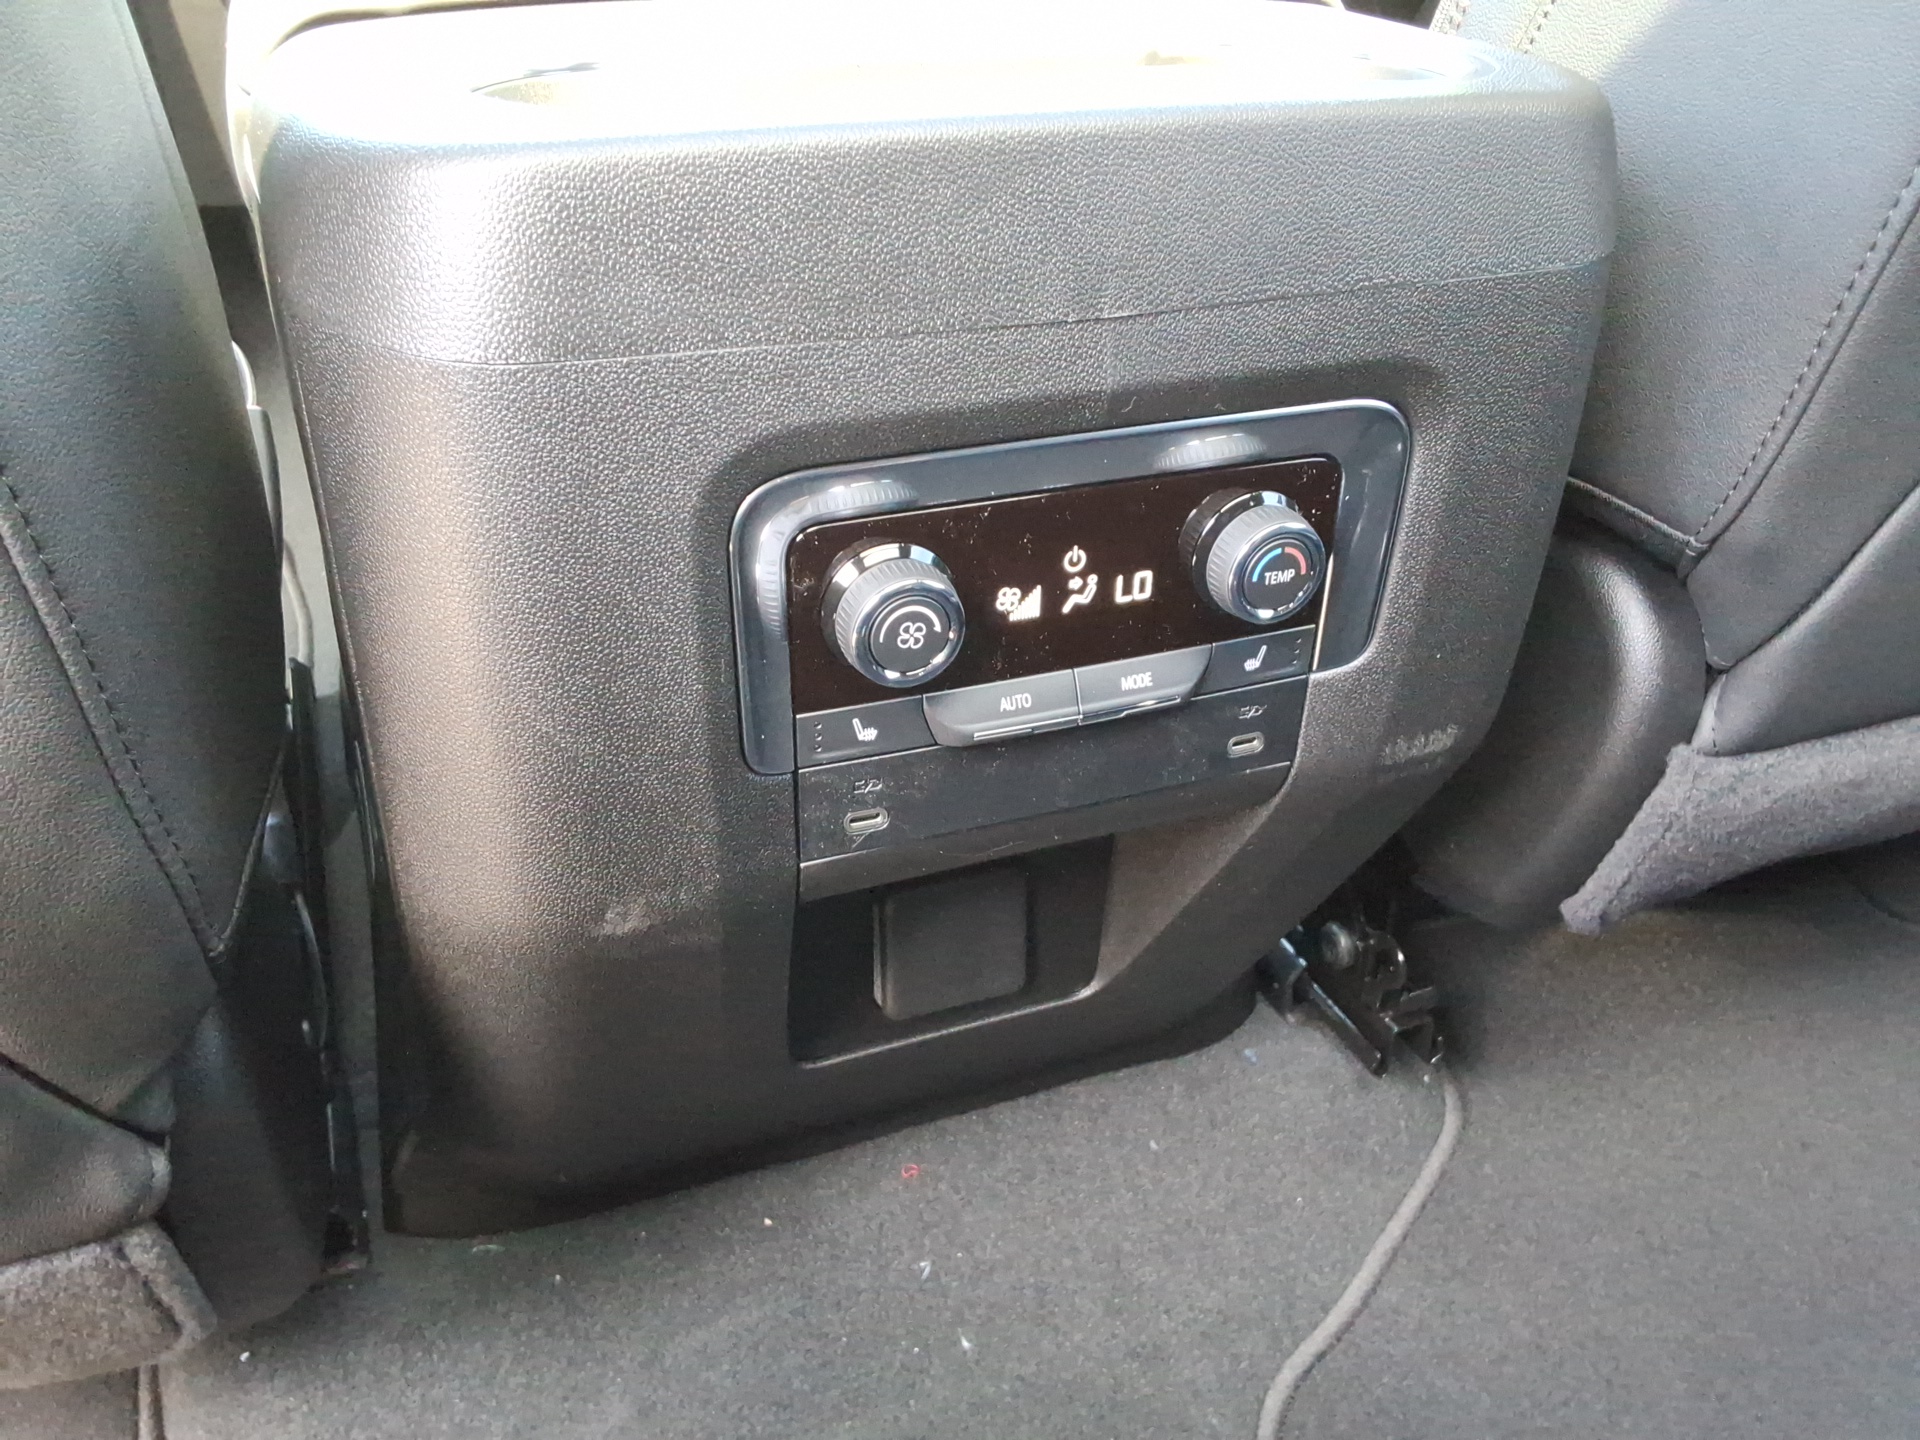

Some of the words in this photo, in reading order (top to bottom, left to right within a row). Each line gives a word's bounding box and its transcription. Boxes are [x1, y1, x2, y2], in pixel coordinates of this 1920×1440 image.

[1264, 568, 1296, 585] TEMP
[1114, 569, 1153, 604] LO
[1121, 672, 1153, 691] MODE
[1000, 692, 1032, 712] AUTO
